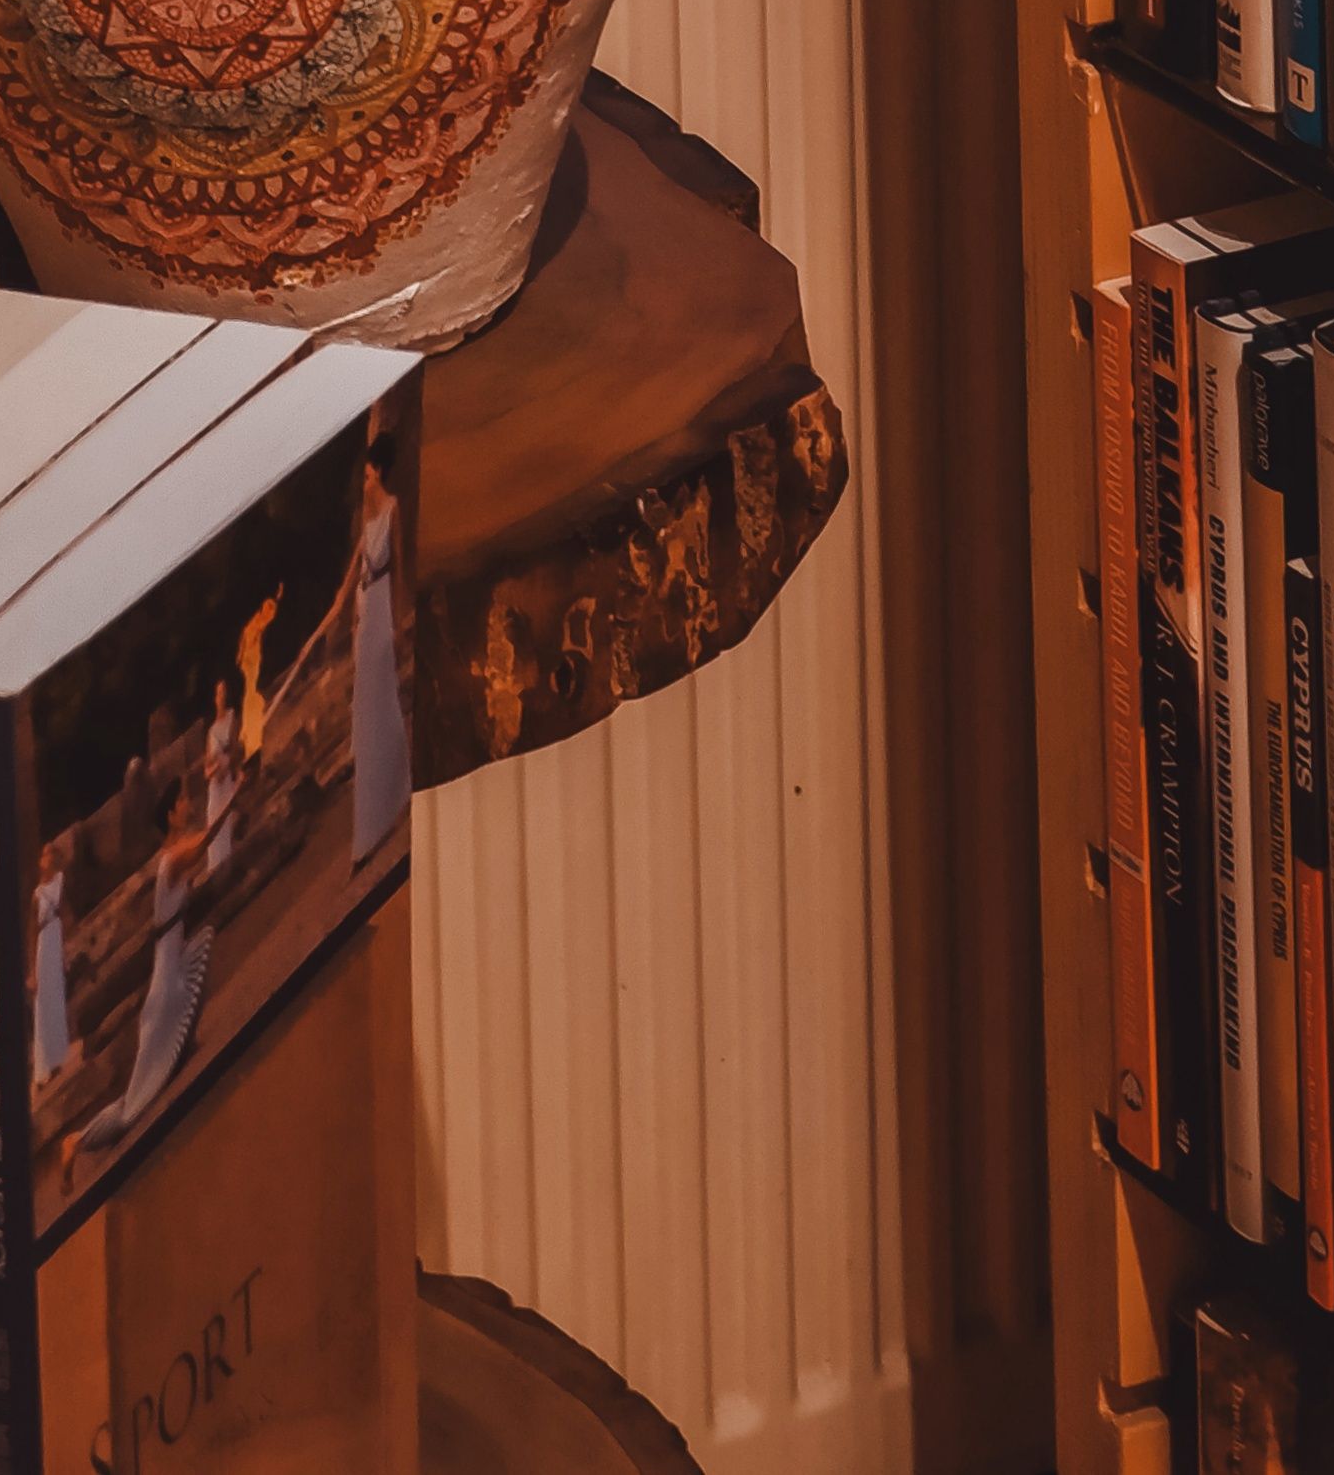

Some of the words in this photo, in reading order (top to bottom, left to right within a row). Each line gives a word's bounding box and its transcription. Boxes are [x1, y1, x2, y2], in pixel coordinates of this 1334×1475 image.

[1151, 285, 1177, 365] THE
[1154, 373, 1185, 594] BALKANS
[1290, 616, 1313, 793] CYPRUS
[1158, 699, 1184, 906] CRAMPTON
